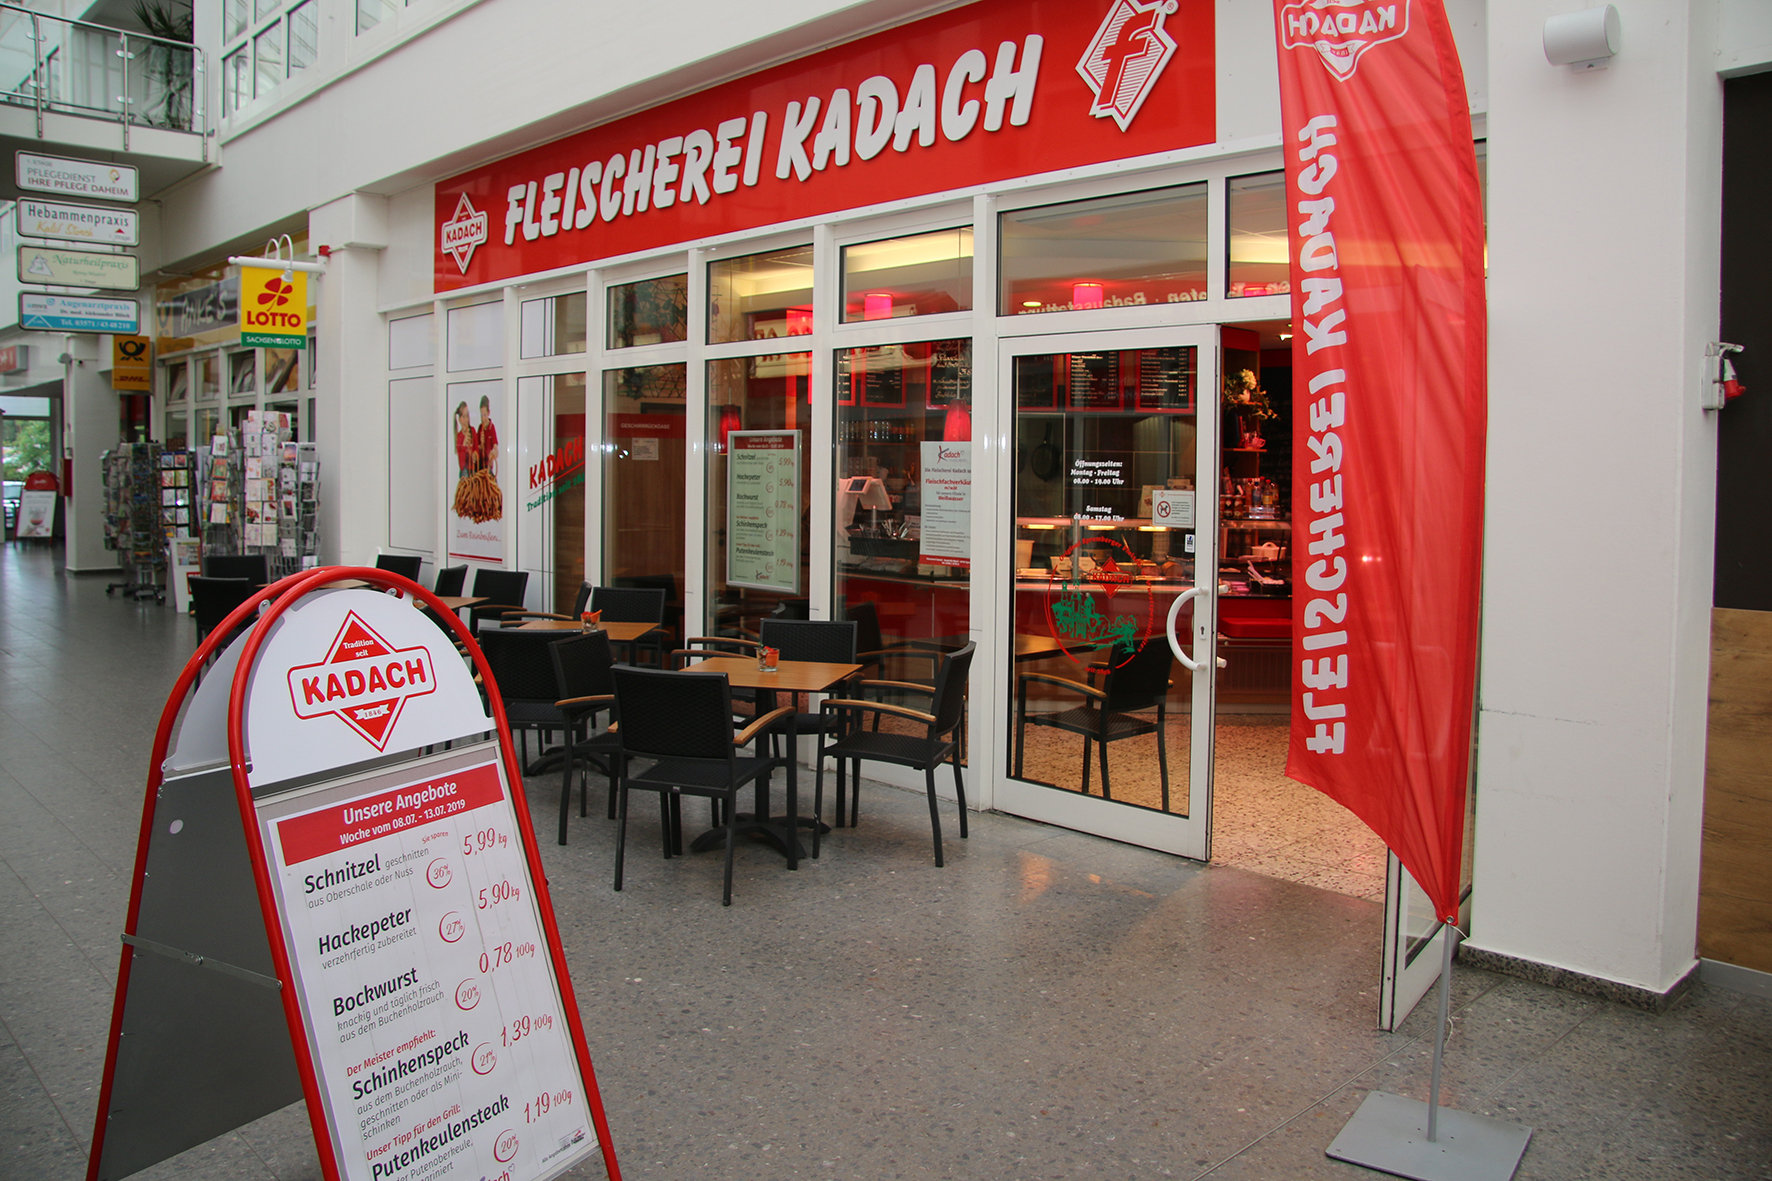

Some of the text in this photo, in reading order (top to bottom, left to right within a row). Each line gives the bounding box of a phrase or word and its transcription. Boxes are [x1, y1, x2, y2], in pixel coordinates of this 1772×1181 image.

[504, 33, 1045, 246] FLEISCHEREI KADACH
[27, 167, 97, 183] PFLEGEDIENST
[28, 177, 130, 195] IHRE PFLEGE DAHEIM
[28, 204, 130, 227] Hebammenpraxis
[446, 221, 483, 244] KADACH
[52, 254, 130, 270] Naturheilpraxis
[60, 300, 131, 311] Augenarztpraxis
[247, 310, 301, 328] LOTTO
[529, 434, 584, 490] KADACH
[1070, 469, 1093, 477] Montag
[1097, 469, 1120, 477] Freitag
[1086, 505, 1112, 514] Samstag
[1092, 572, 1130, 584] KADACH
[343, 639, 375, 650] Tradition
[355, 649, 369, 658] seit
[302, 657, 427, 706] KADACH
[364, 709, 382, 718] 1846
[343, 782, 457, 825] Unsere Angebote
[340, 828, 371, 845] Woche
[371, 823, 392, 835] vom
[392, 814, 418, 829] 08.07.
[424, 805, 447, 820] 13.07.
[447, 799, 466, 814] 2019
[463, 827, 508, 855] 5,99 kg
[304, 848, 430, 894] Schnitzel geschnitten
[433, 864, 451, 880] 36%
[308, 866, 414, 909] aus Oberschale oder Nuss
[478, 880, 520, 909] 5,90 kg
[318, 908, 412, 955] Hackepeter
[445, 918, 464, 936] 27%
[322, 927, 417, 970] verzehrfertig zubereitet
[478, 942, 535, 973] 0,78 100g
[333, 967, 419, 1017] Bockwurst
[337, 980, 441, 1031] knackig und täglich frisch
[461, 985, 479, 1003] 20%
[340, 990, 445, 1043] aus dem Buchenholzrauch
[500, 1014, 553, 1047] 1,39 100g
[346, 1029, 437, 1077] Der Meister empfiehlt:
[352, 1030, 470, 1100] Schinkenspeck
[480, 1049, 496, 1067] 21%
[357, 1056, 463, 1115] aus dem Buchenholzrauch,
[360, 1069, 463, 1130] geschnitten oder als Mini-
[524, 1089, 572, 1124] 1,19 100g
[363, 1115, 401, 1140] schinken
[366, 1103, 461, 1161] Unser Tipp für den Grill:
[372, 1093, 510, 1181] Putenkeulensteak
[501, 1133, 519, 1153] 20%
[411, 1139, 474, 1179] Putenoberkeule,
